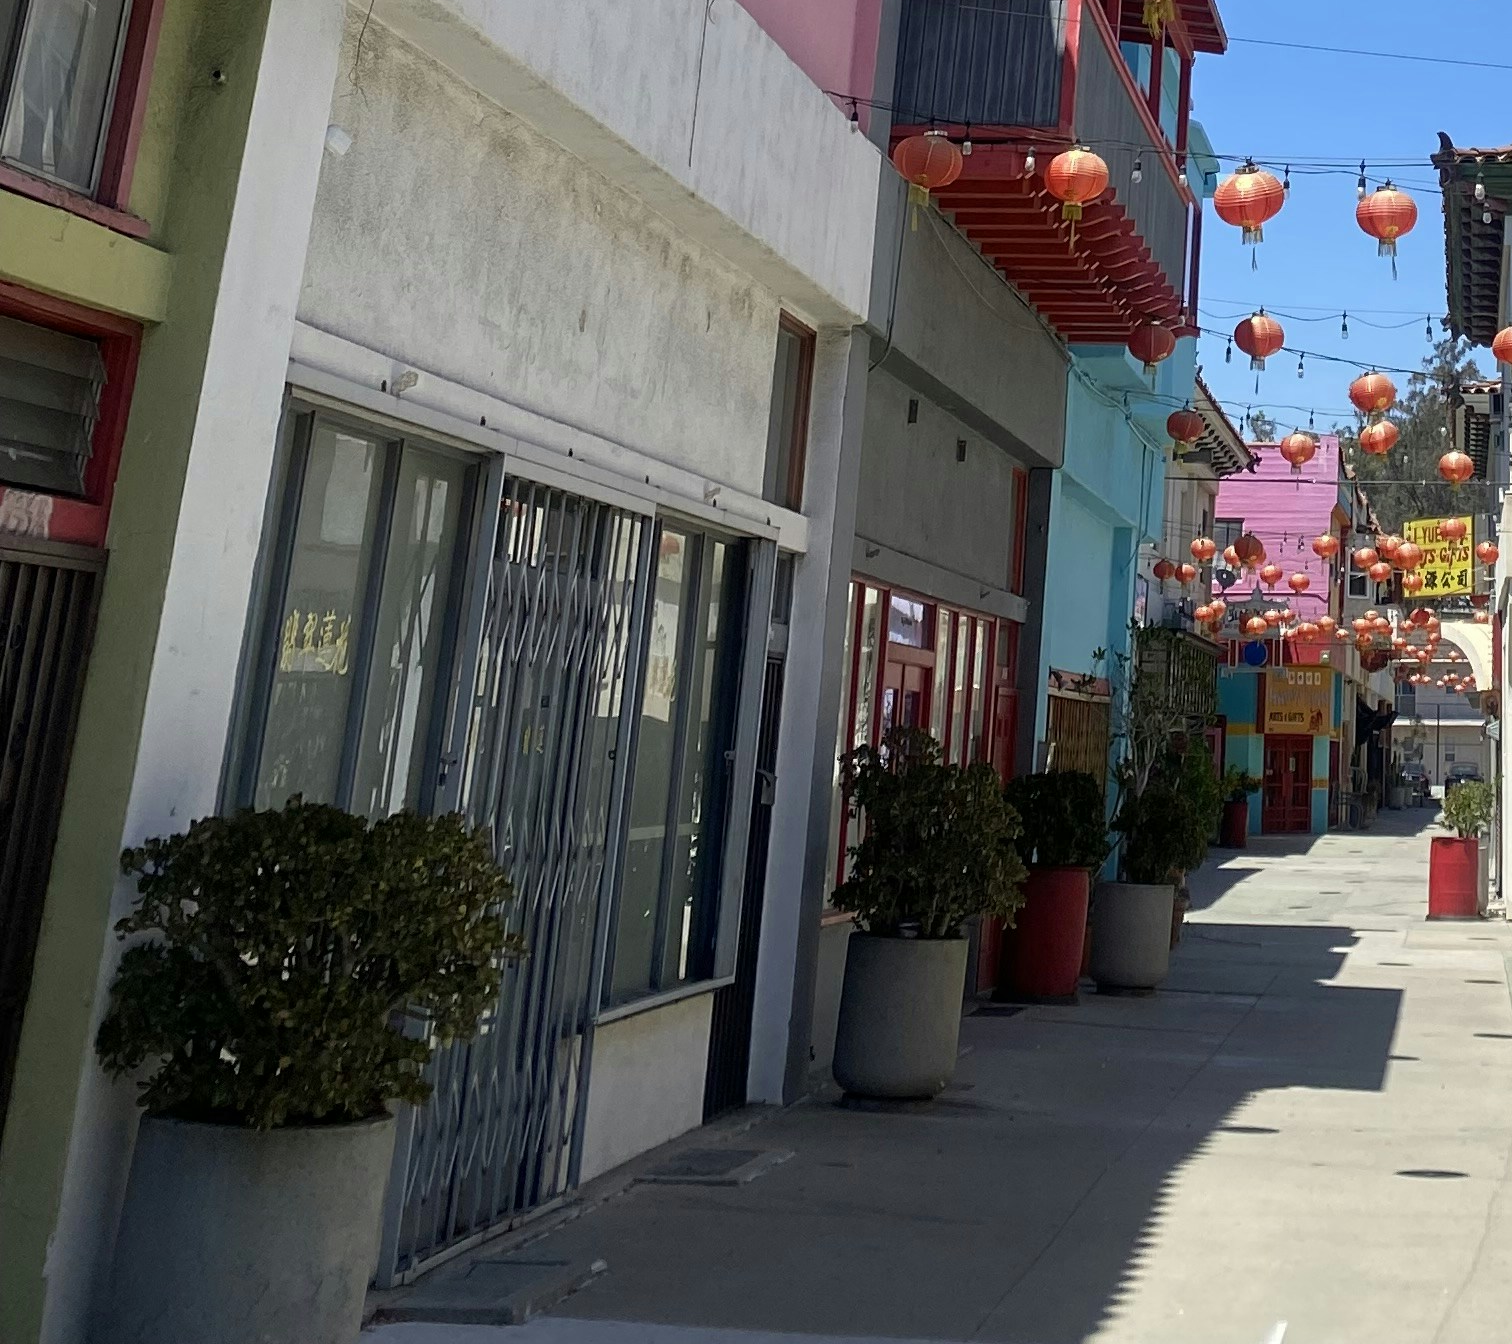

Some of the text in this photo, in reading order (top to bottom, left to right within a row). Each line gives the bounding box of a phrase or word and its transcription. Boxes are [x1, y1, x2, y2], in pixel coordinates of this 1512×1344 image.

[1422, 526, 1447, 544] YUE
[1416, 568, 1468, 590] 源公司
